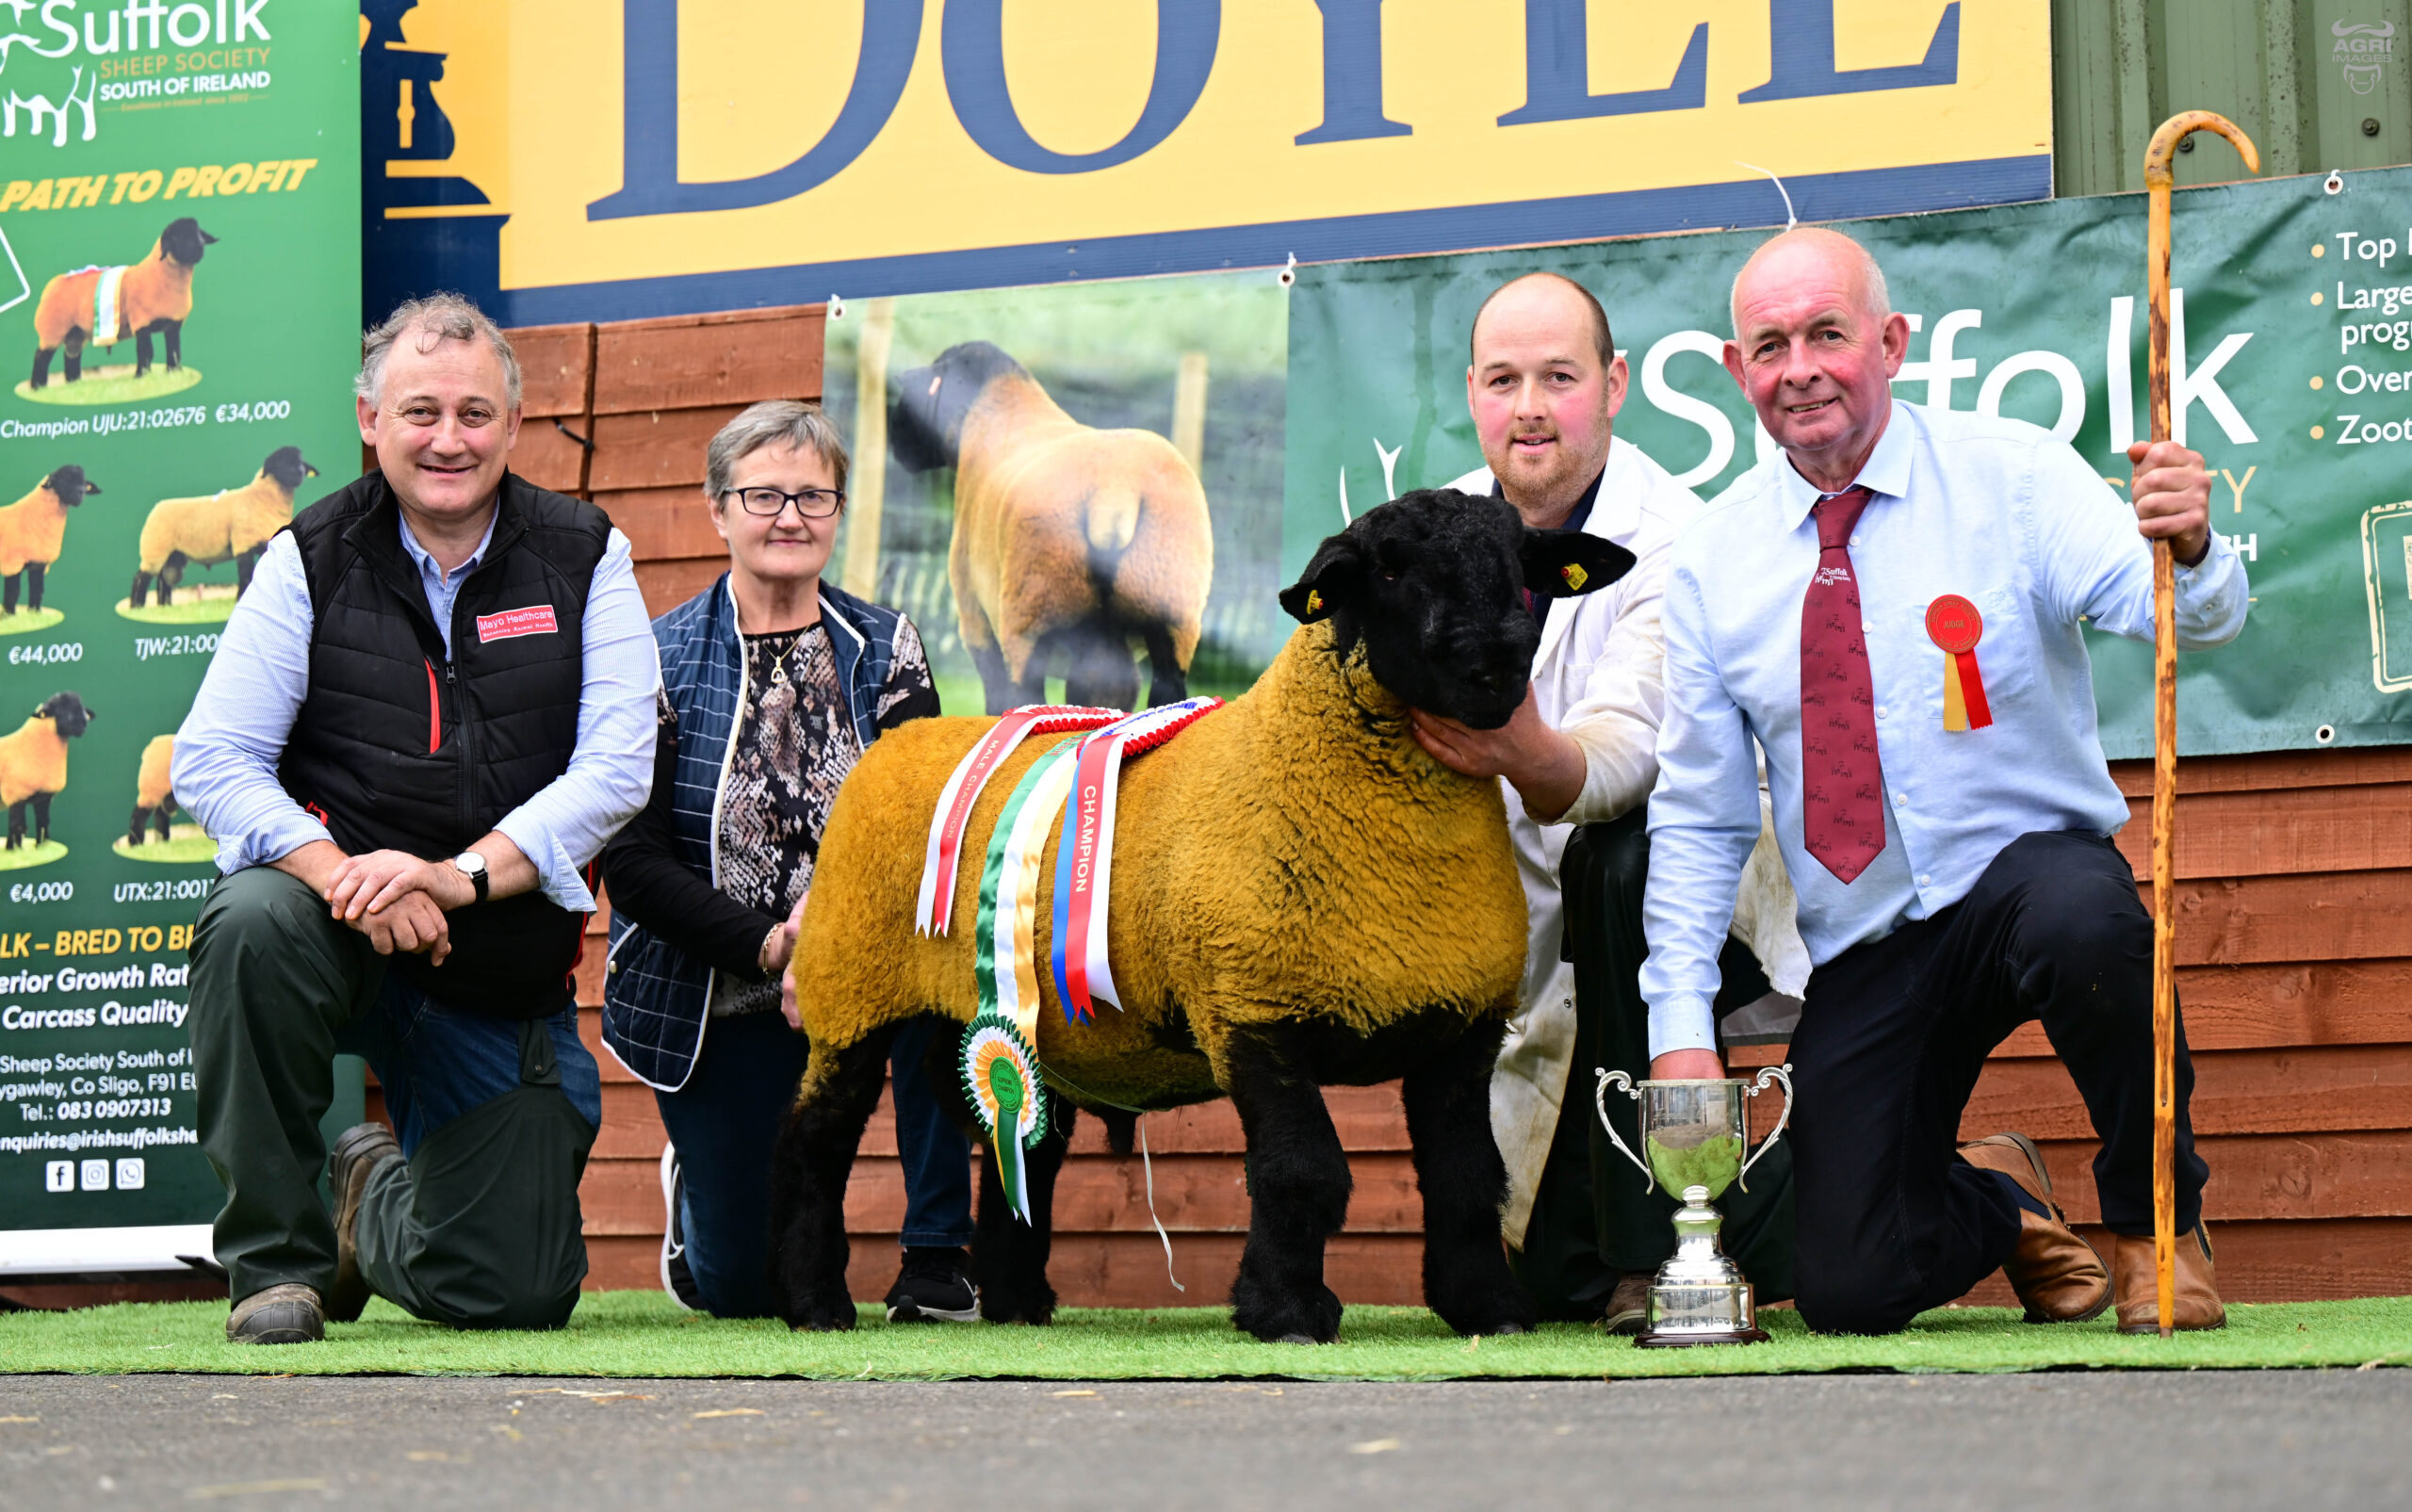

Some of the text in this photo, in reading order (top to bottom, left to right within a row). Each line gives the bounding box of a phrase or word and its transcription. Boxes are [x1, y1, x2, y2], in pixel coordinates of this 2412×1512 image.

[41, 0, 271, 58] Suffolk
[100, 47, 270, 79] SHEEP SOCIETY
[100, 71, 271, 101] SOUTH OF IRELAND
[0, 158, 318, 212] PATH TO PROFIT
[2336, 232, 2397, 268] Top
[2341, 321, 2412, 354] prog
[1640, 287, 2259, 489] Sfolk
[1, 400, 291, 439] Champion UJU:21:02676 €34,000
[480, 610, 553, 630] Mayo Healthcare
[1944, 620, 1966, 629] JUDGE
[8, 642, 83, 665] €44,000
[947, 740, 1000, 838] MALE CHAMPION
[1076, 785, 1097, 893] CHAMPION
[10, 881, 73, 904] €4,000
[54, 928, 122, 956] BRED
[127, 925, 164, 953] TO
[57, 963, 145, 992] Growth
[2, 998, 188, 1030] Carcass Quality
[0, 1055, 53, 1076] Sheep
[55, 1052, 114, 1073] Society
[117, 1049, 165, 1069] South
[167, 1048, 187, 1066] of
[71, 1077, 96, 1095] Co
[98, 1075, 144, 1097] Sligo,
[148, 1072, 176, 1092] F91
[20, 1097, 172, 1121] Tel.: 083 0907313
